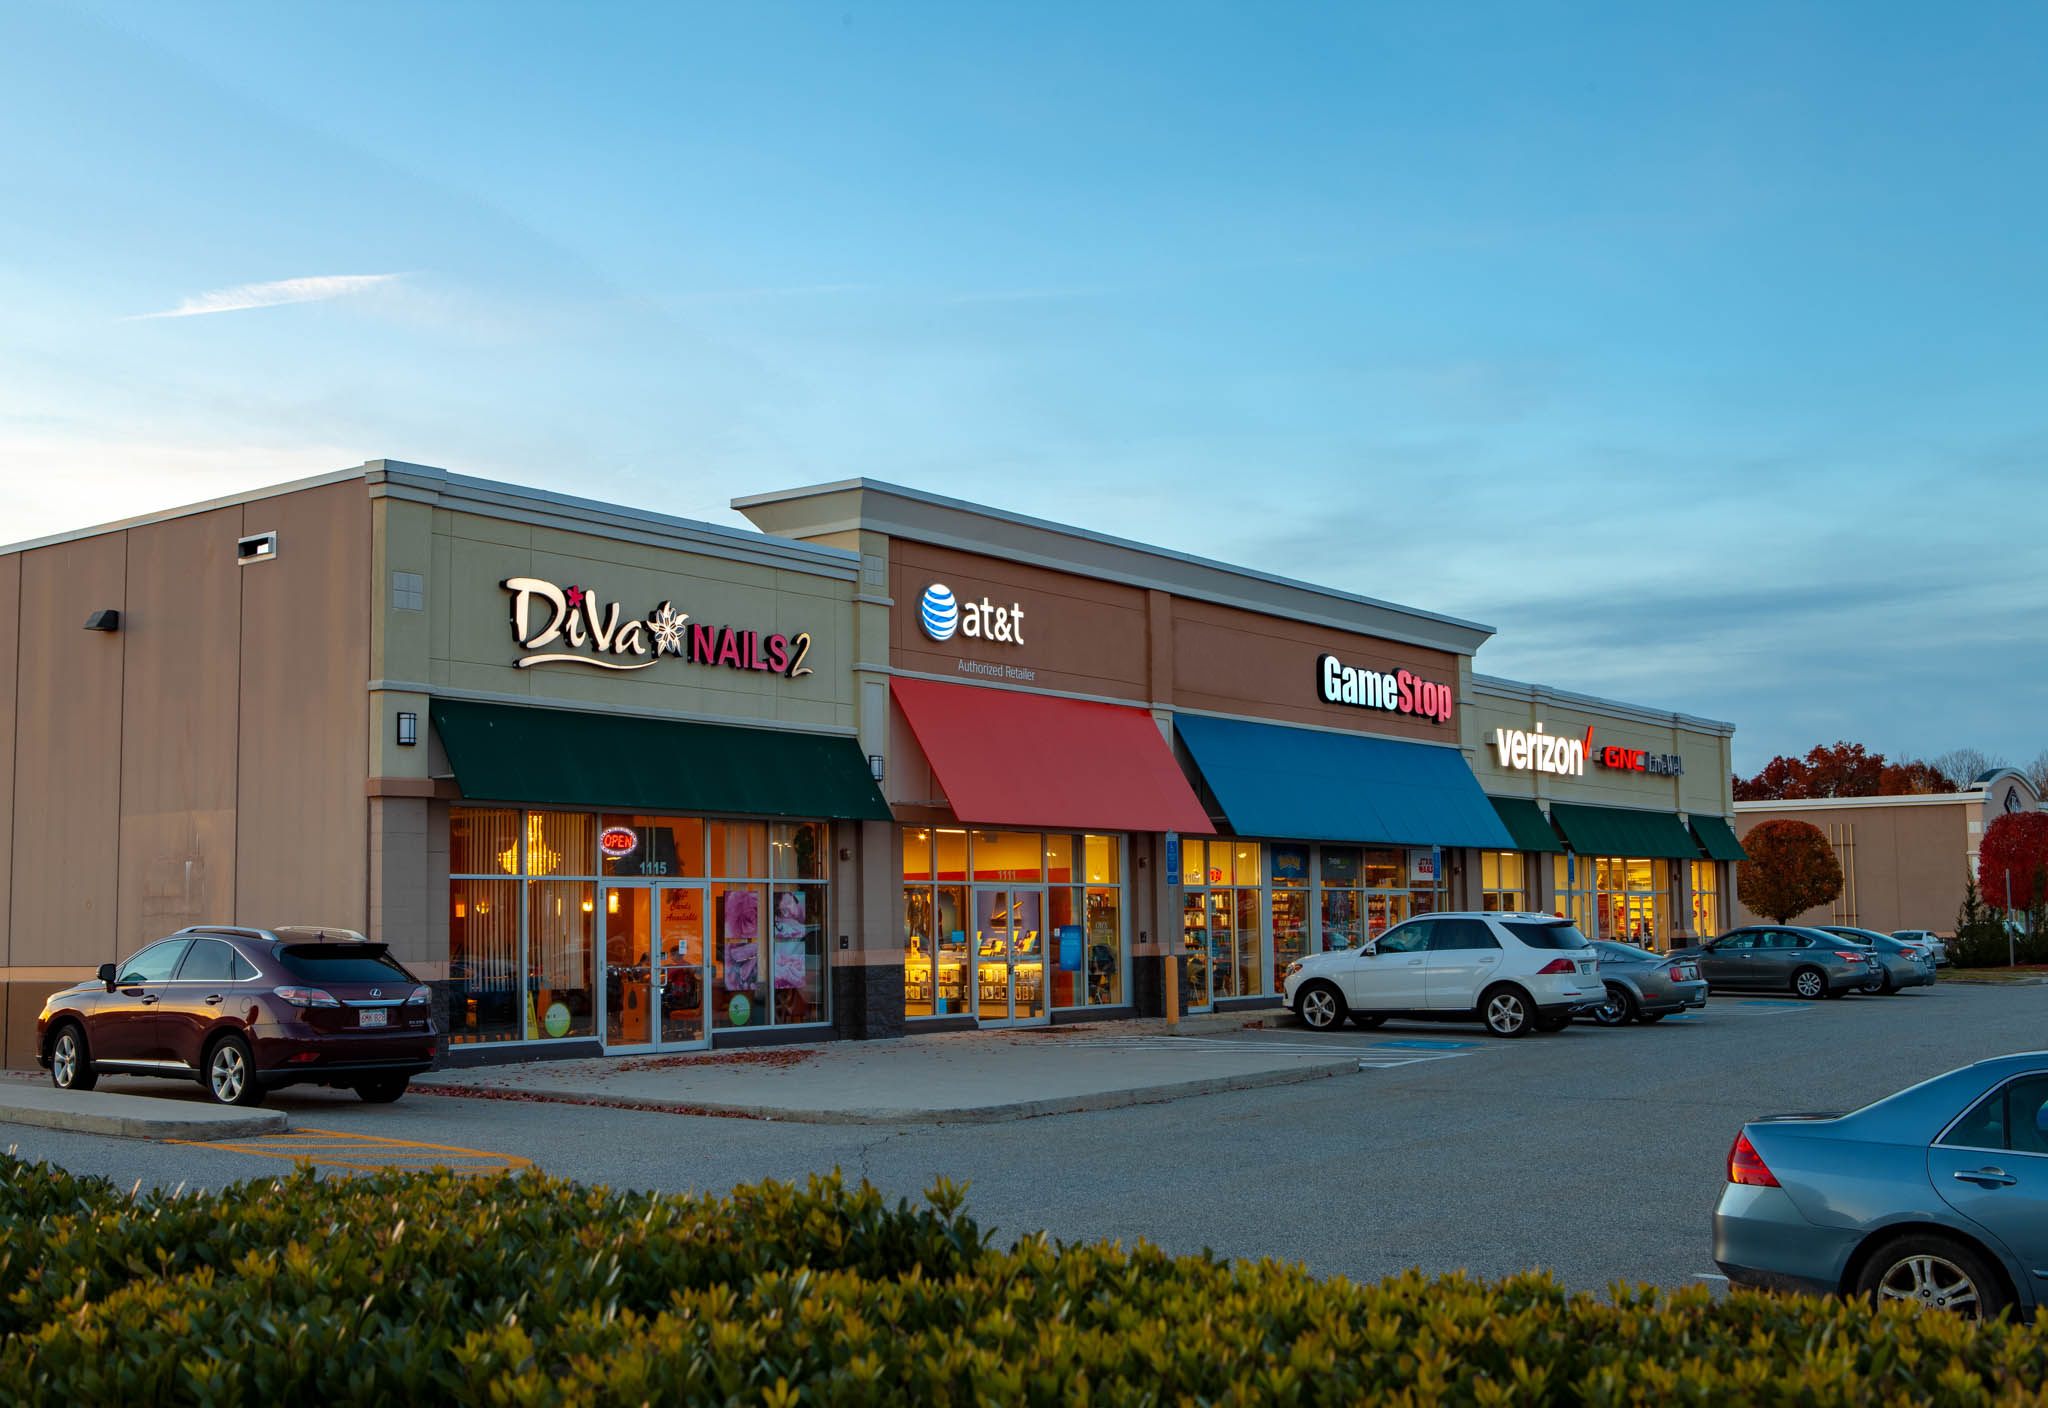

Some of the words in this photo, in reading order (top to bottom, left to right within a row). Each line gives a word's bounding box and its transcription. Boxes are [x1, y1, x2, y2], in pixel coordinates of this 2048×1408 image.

[500, 577, 646, 656] DiVa
[962, 597, 1024, 645] at&t
[689, 623, 788, 673] NAILS
[786, 632, 814, 678] 2
[958, 659, 1003, 676] Authorized
[1005, 666, 1035, 680] Retailer
[1320, 655, 1452, 722] GameStop
[1496, 722, 1584, 776] verizon
[1603, 746, 1646, 772] GNC
[604, 834, 632, 848] OPEN
[640, 862, 667, 874] 1115
[998, 870, 1016, 881] 1111
